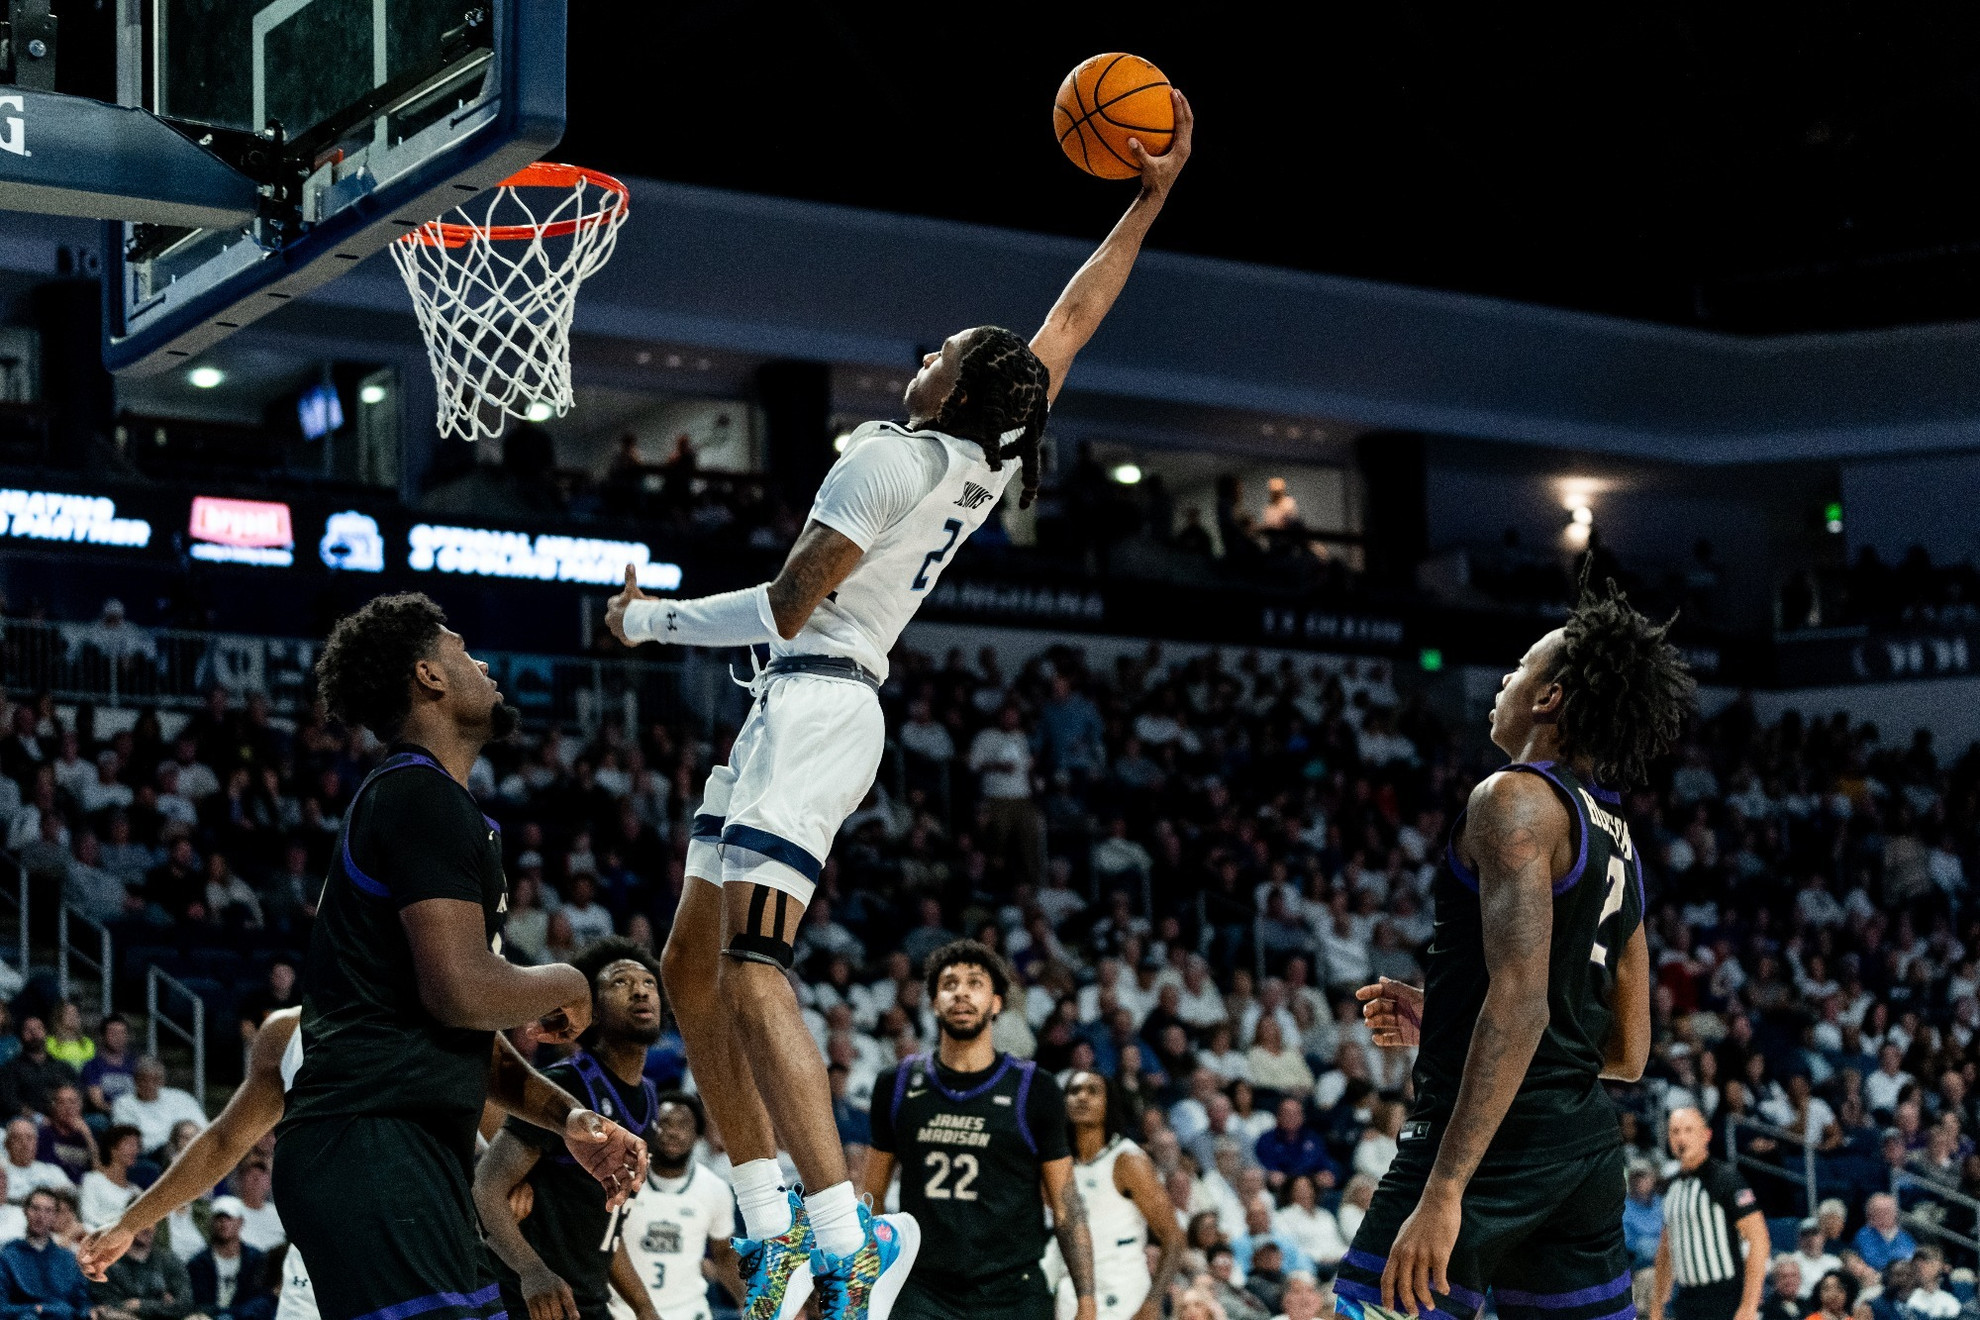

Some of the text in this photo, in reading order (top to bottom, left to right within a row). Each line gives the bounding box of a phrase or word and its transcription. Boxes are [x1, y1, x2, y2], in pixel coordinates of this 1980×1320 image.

[910, 516, 964, 591] 2
[560, 555, 681, 588] PARTER
[915, 1127, 993, 1148] MADISON
[926, 1113, 987, 1131] JAMES
[923, 1150, 981, 1202] 22
[651, 1261, 666, 1290] 3
